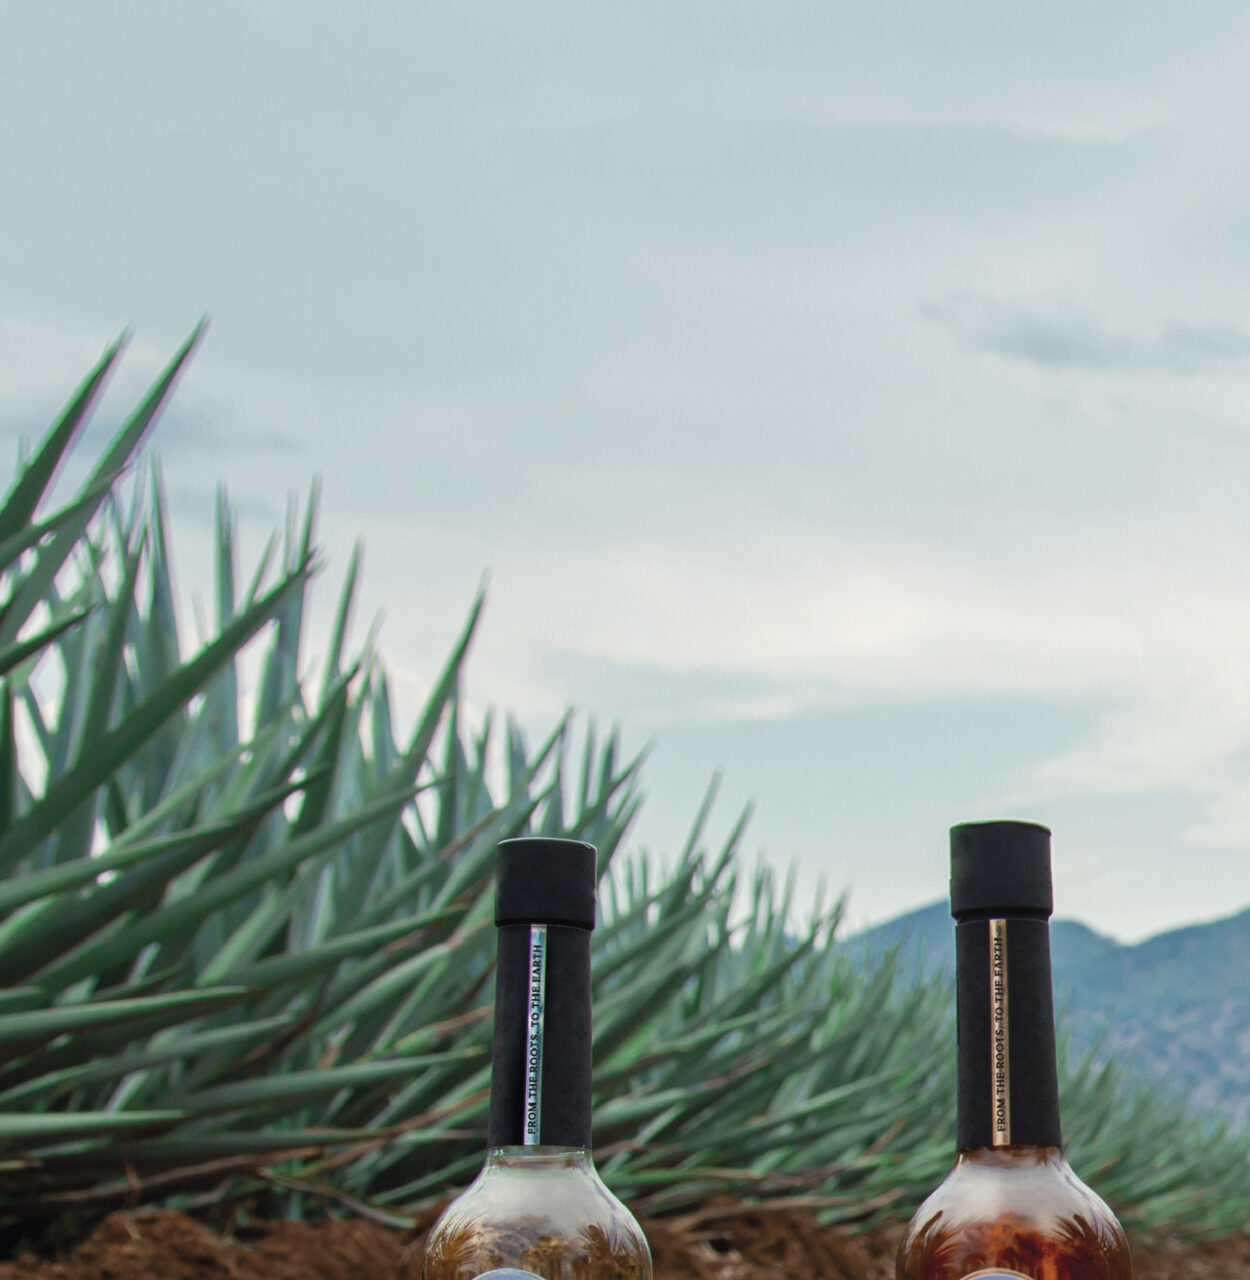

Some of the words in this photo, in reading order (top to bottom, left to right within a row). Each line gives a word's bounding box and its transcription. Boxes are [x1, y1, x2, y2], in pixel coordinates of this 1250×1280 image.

[532, 945, 542, 982] EARTH
[994, 937, 1003, 976] EARTH
[531, 986, 541, 1008] THE
[995, 981, 1004, 1002] THE
[530, 1013, 540, 1028] TO
[995, 1007, 1005, 1022] TO
[528, 1077, 538, 1099] THE
[996, 1073, 1005, 1095] THE
[527, 1102, 536, 1134] FROM
[996, 1100, 1006, 1131] FROM
